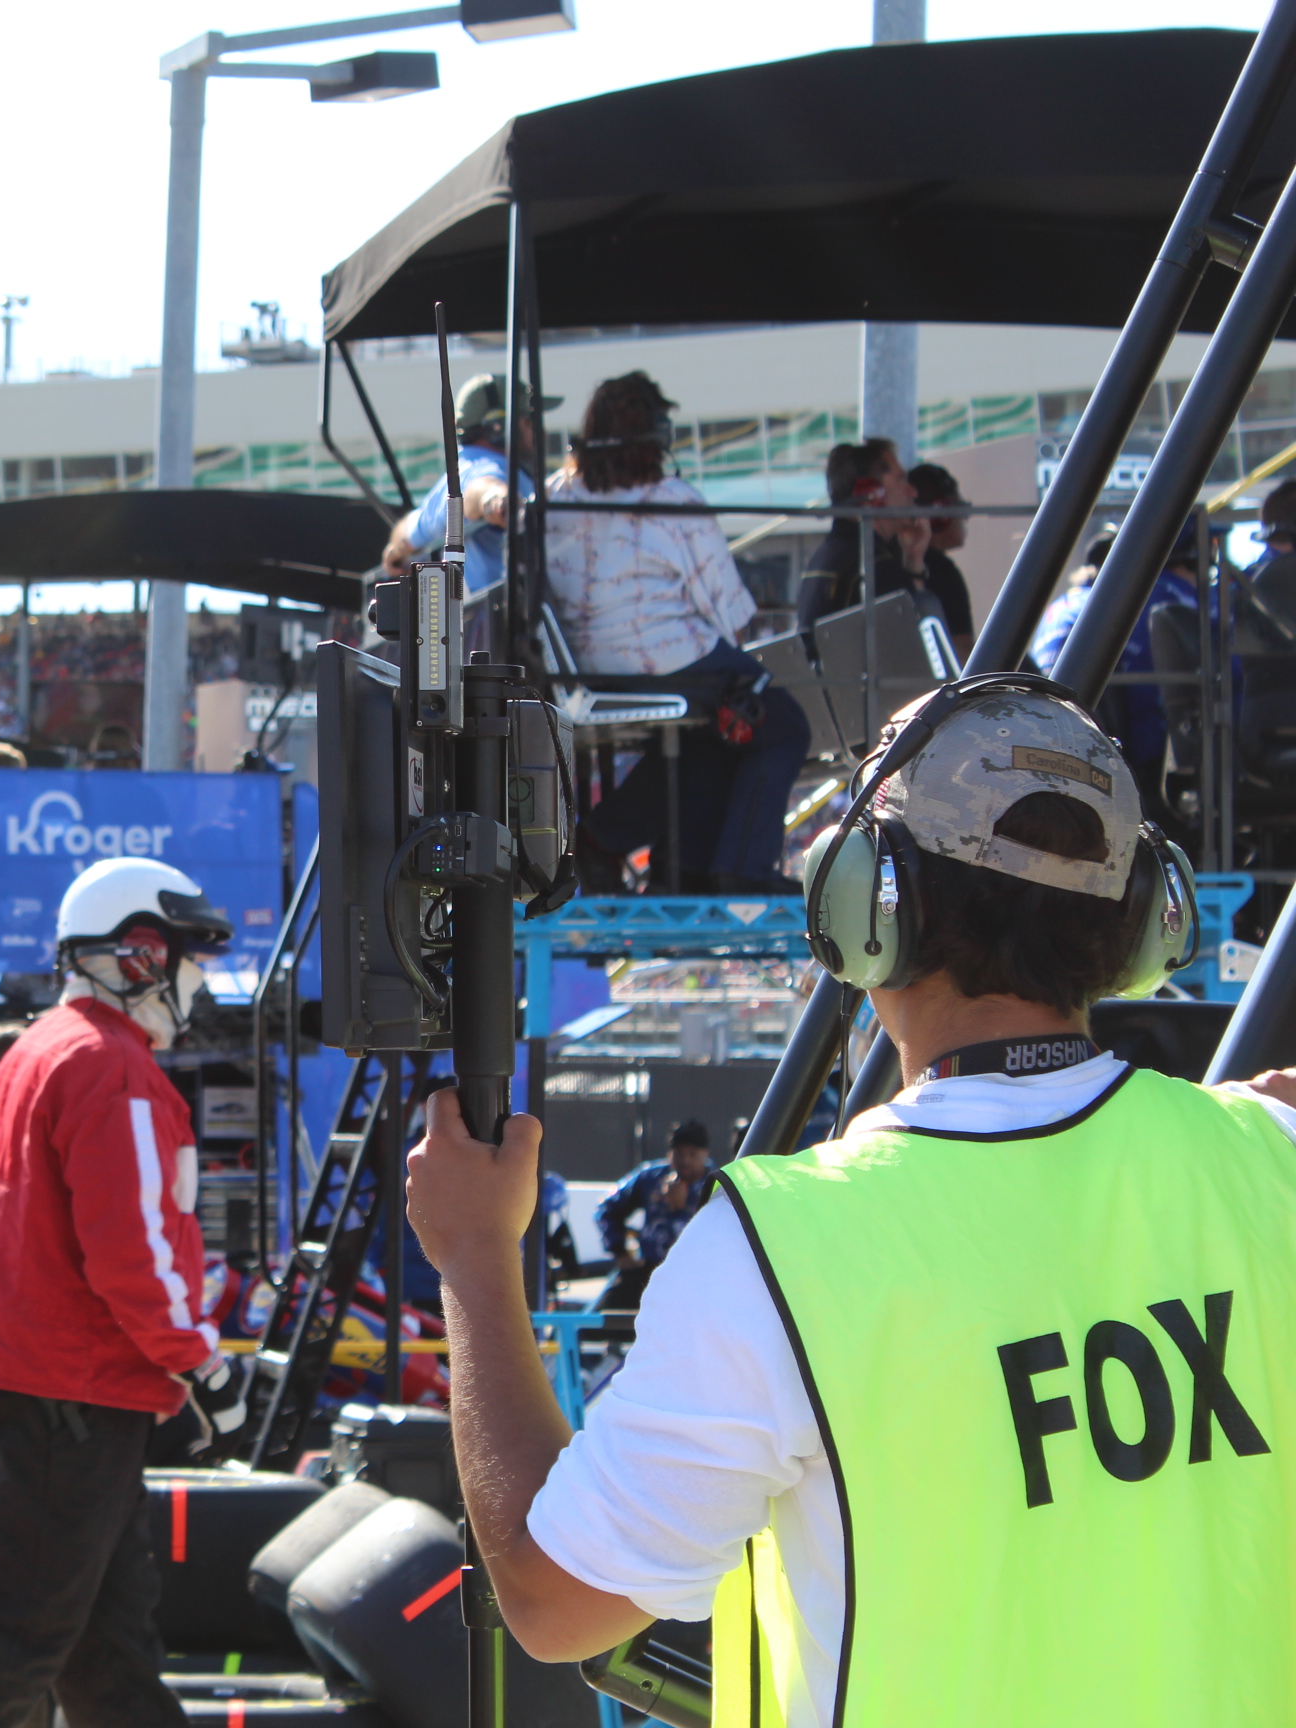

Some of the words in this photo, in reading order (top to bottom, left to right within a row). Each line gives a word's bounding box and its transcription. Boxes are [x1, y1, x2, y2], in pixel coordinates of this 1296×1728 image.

[1026, 752, 1081, 777] Carolina
[1091, 770, 1109, 790] CAT
[7, 789, 173, 860] Kroger
[1005, 1040, 1088, 1071] NASCAR
[996, 1290, 1273, 1510] FOX
